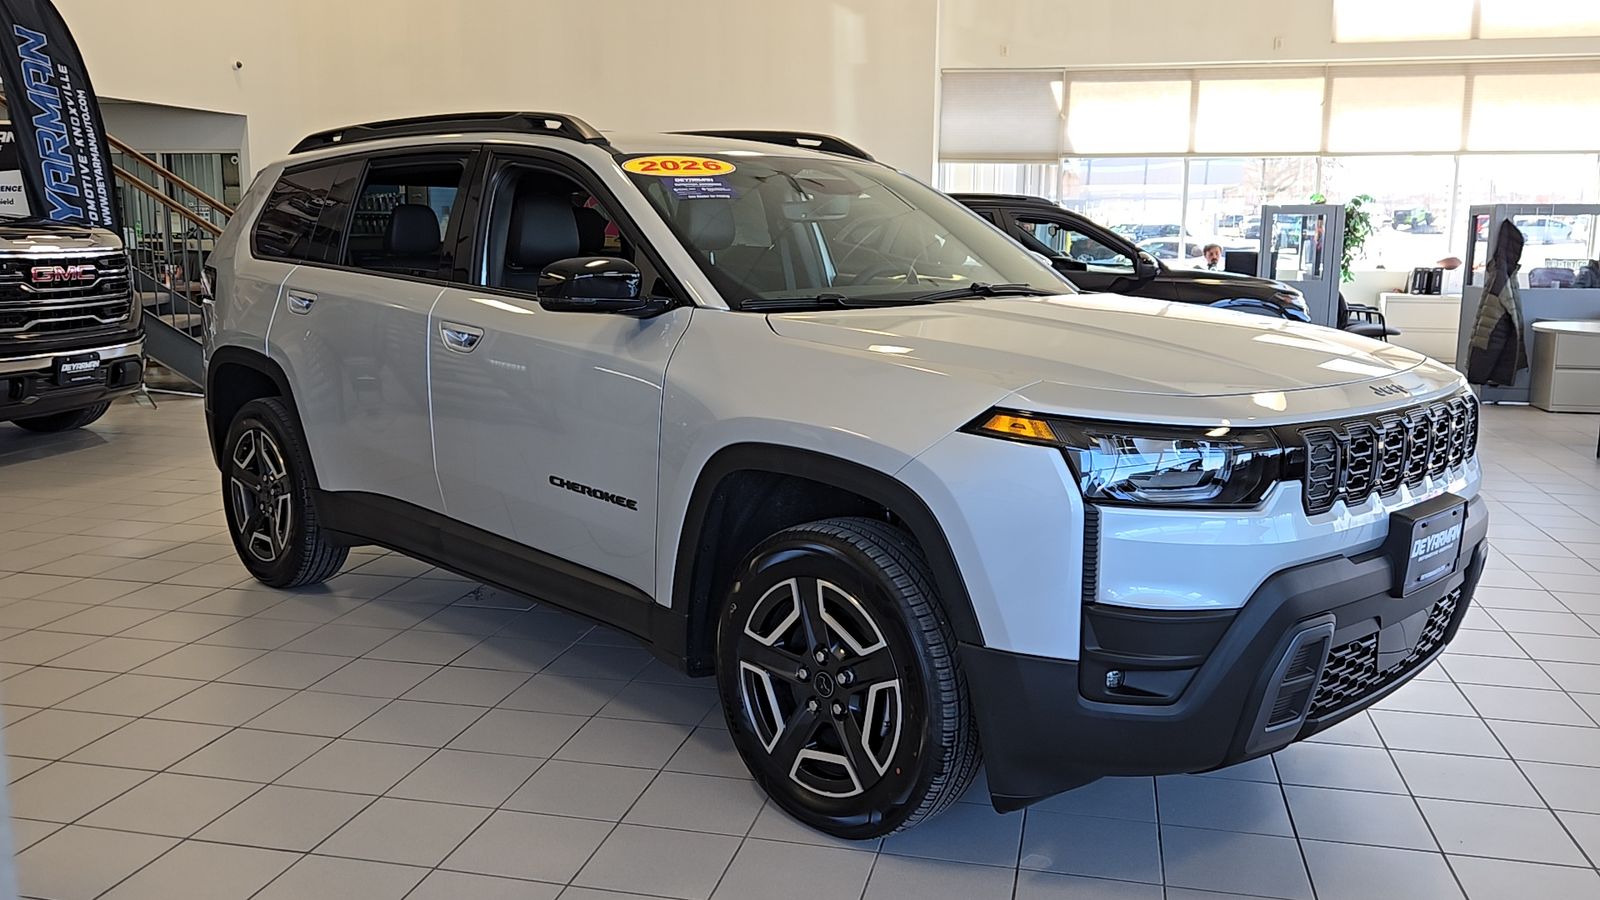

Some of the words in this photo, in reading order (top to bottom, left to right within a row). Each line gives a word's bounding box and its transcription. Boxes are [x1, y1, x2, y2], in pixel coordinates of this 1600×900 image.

[13, 24, 84, 221] YARMAN
[57, 63, 85, 147] KNOXVILLE
[76, 89, 113, 226] WWW.DEYARMANAUTO.COM
[638, 160, 722, 171] 2026
[31, 264, 96, 283] GMC
[548, 475, 639, 512] CHEROKEE
[1410, 521, 1462, 559] DEYARMAN
